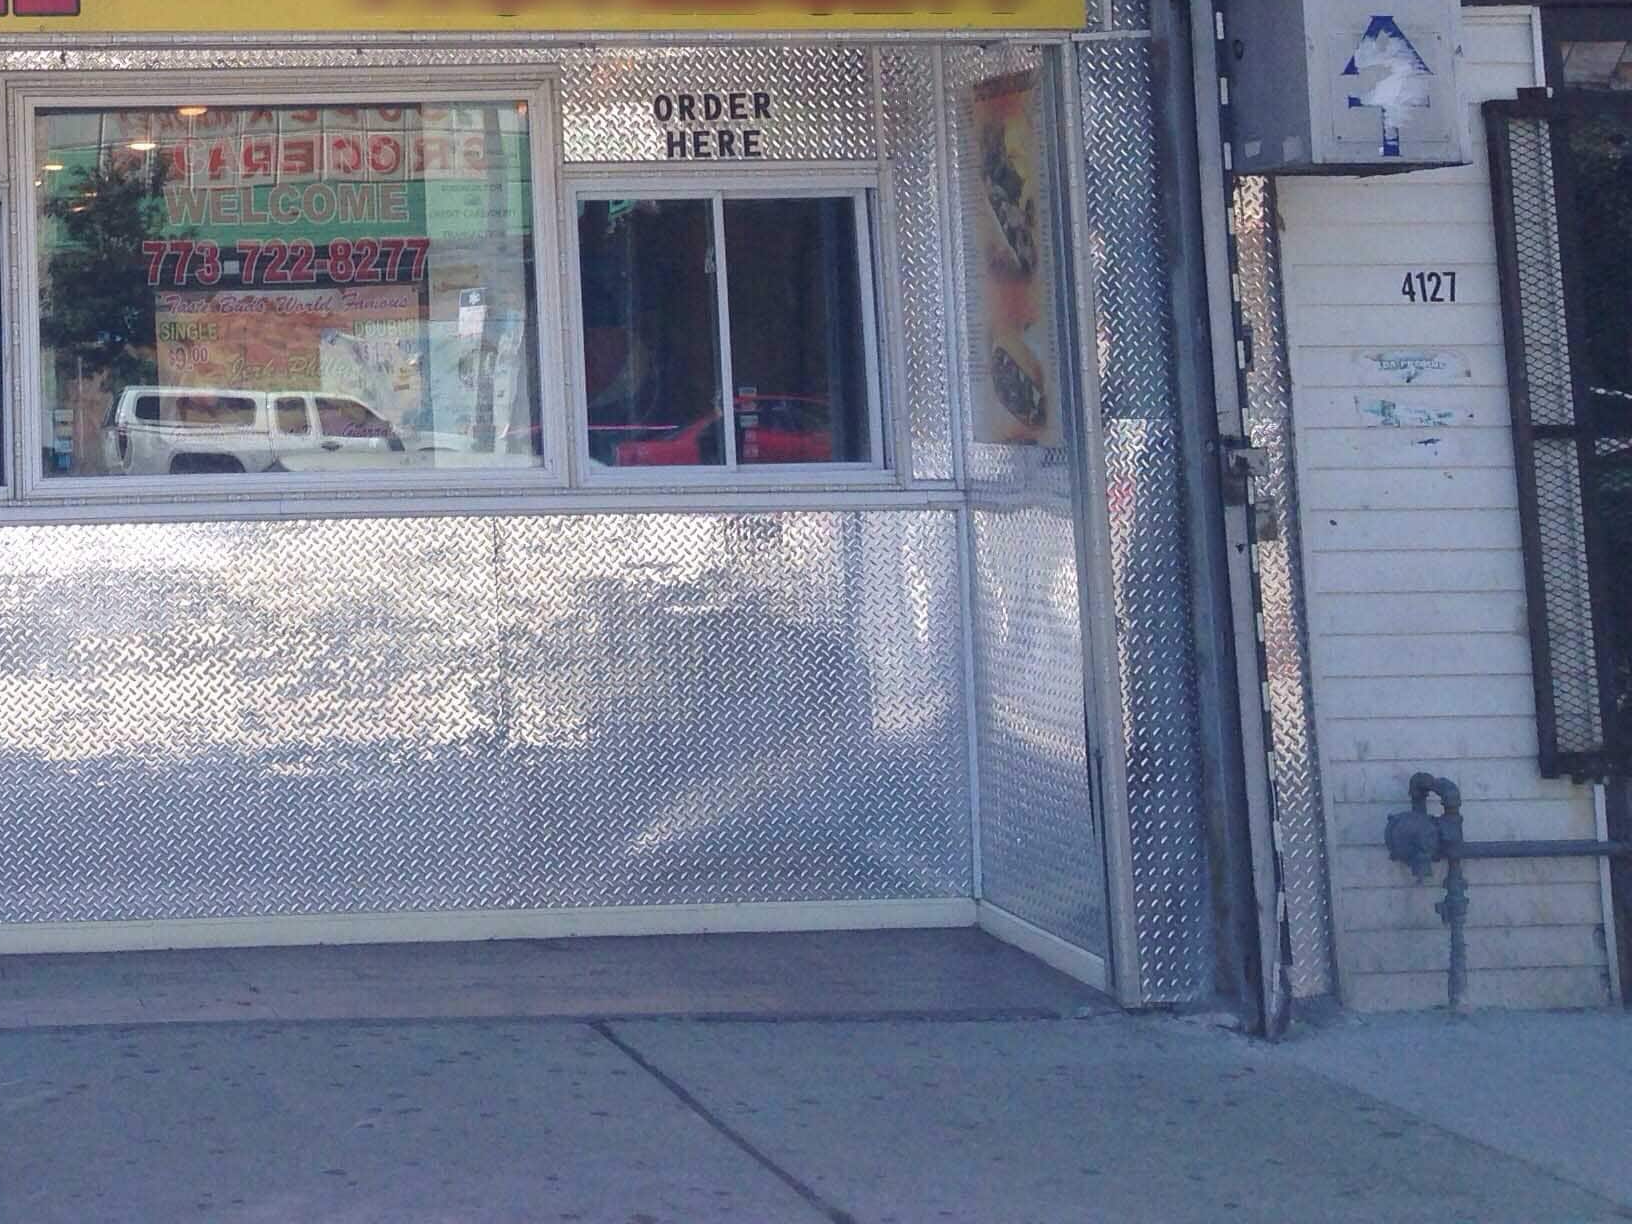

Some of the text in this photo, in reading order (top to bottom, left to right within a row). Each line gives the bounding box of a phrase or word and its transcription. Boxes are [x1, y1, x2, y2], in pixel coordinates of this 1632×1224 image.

[653, 92, 772, 122] ORDER
[666, 130, 762, 158] HERE
[165, 182, 410, 225] WELCOME
[1401, 271, 1456, 303] 4127
[159, 321, 218, 342] SINGLE
